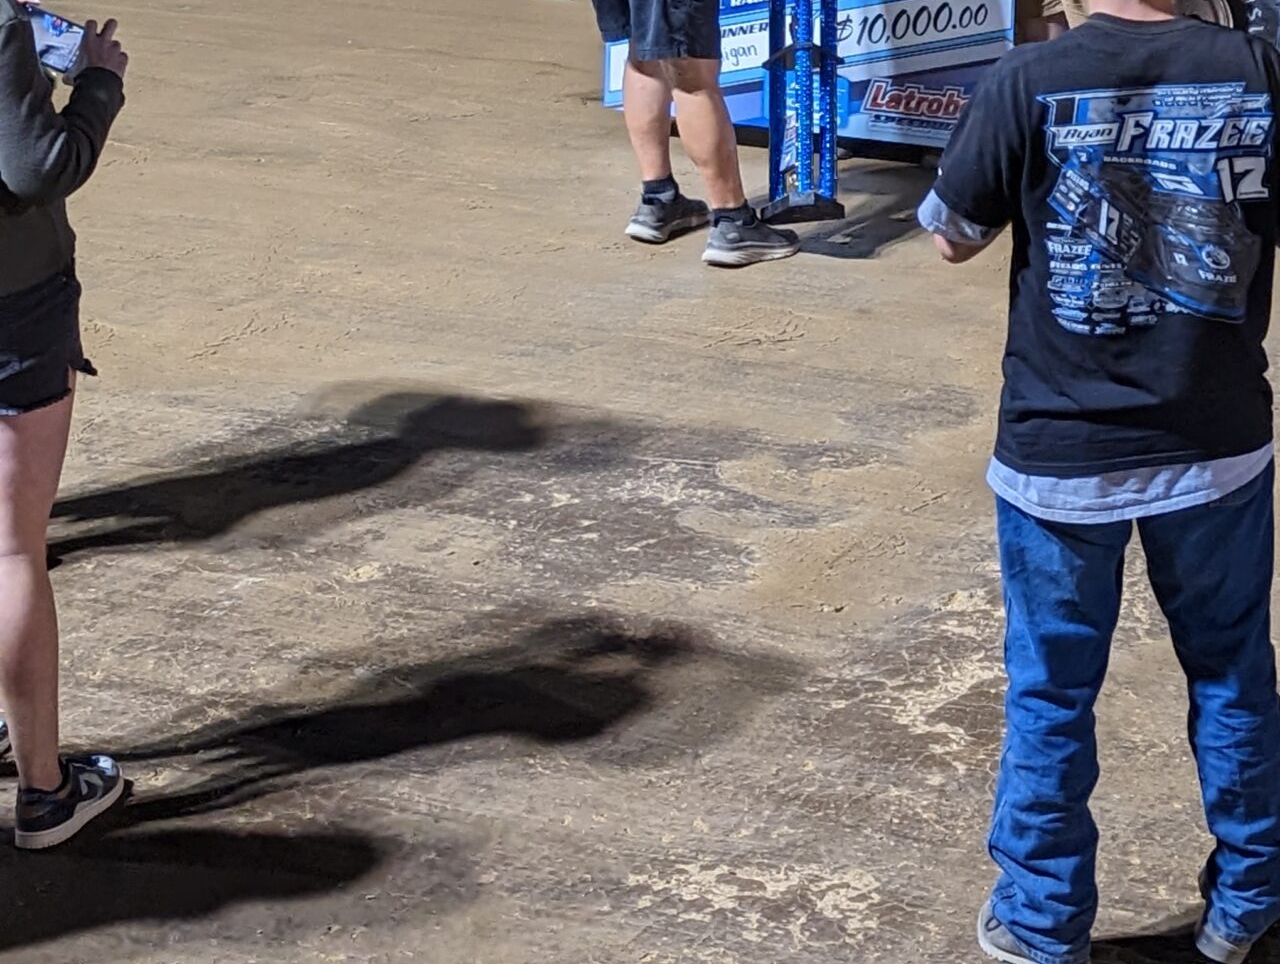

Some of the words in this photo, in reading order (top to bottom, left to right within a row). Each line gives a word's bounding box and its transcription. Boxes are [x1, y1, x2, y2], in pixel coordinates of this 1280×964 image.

[722, 22, 769, 39] INNER
[836, 2, 988, 46] $10,000.00
[723, 43, 758, 67] igan
[1063, 125, 1113, 142] Ryan
[1116, 111, 1273, 153] FRAZEE
